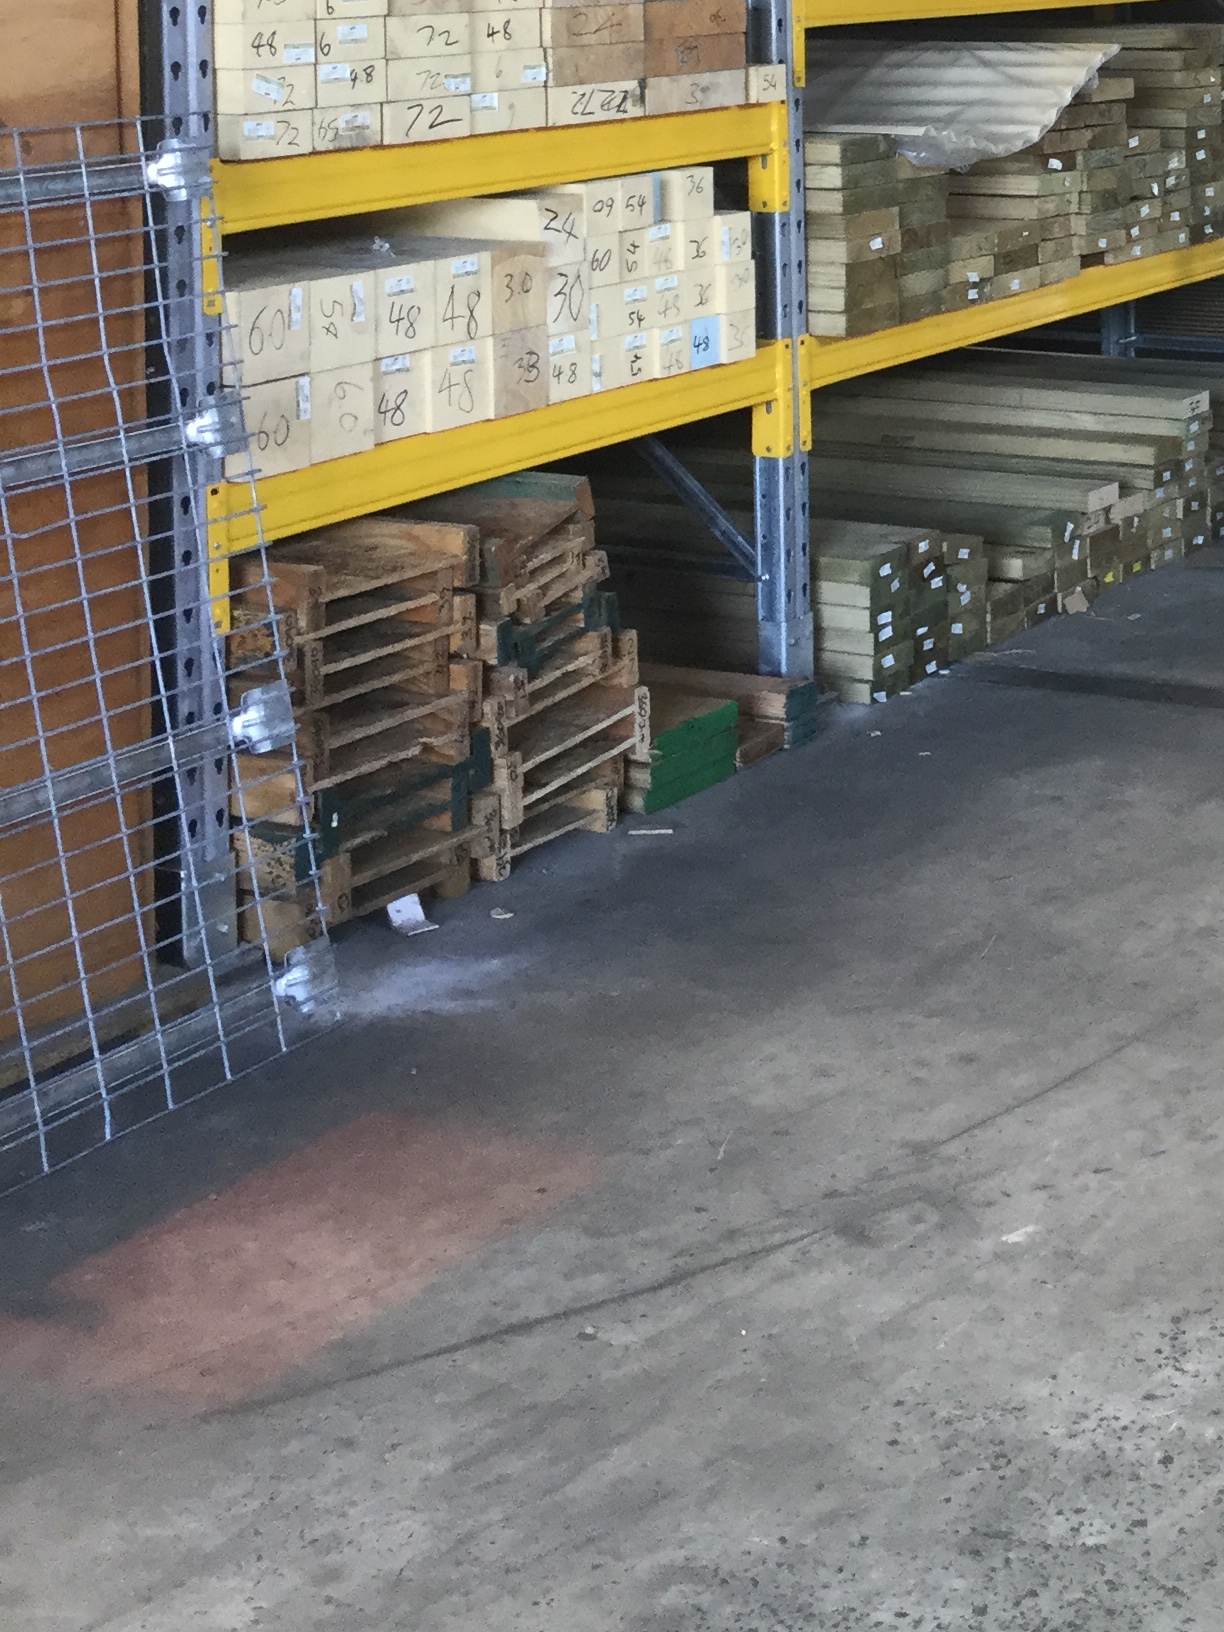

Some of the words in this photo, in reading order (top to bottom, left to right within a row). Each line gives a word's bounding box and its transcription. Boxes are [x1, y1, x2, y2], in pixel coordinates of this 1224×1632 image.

[251, 30, 277, 57] 48
[416, 25, 459, 46] 72
[486, 18, 512, 43] 48
[319, 32, 332, 57] 6
[275, 120, 300, 147] 72
[406, 103, 463, 138] 72
[625, 193, 647, 216] 54
[543, 207, 579, 245] 24
[591, 248, 612, 272] 60
[553, 266, 585, 324] 30
[389, 301, 421, 339] 48
[442, 284, 482, 340] 48
[693, 333, 711, 355] 48
[552, 362, 578, 385] 48
[437, 368, 475, 414] 48
[378, 389, 408, 427] 48
